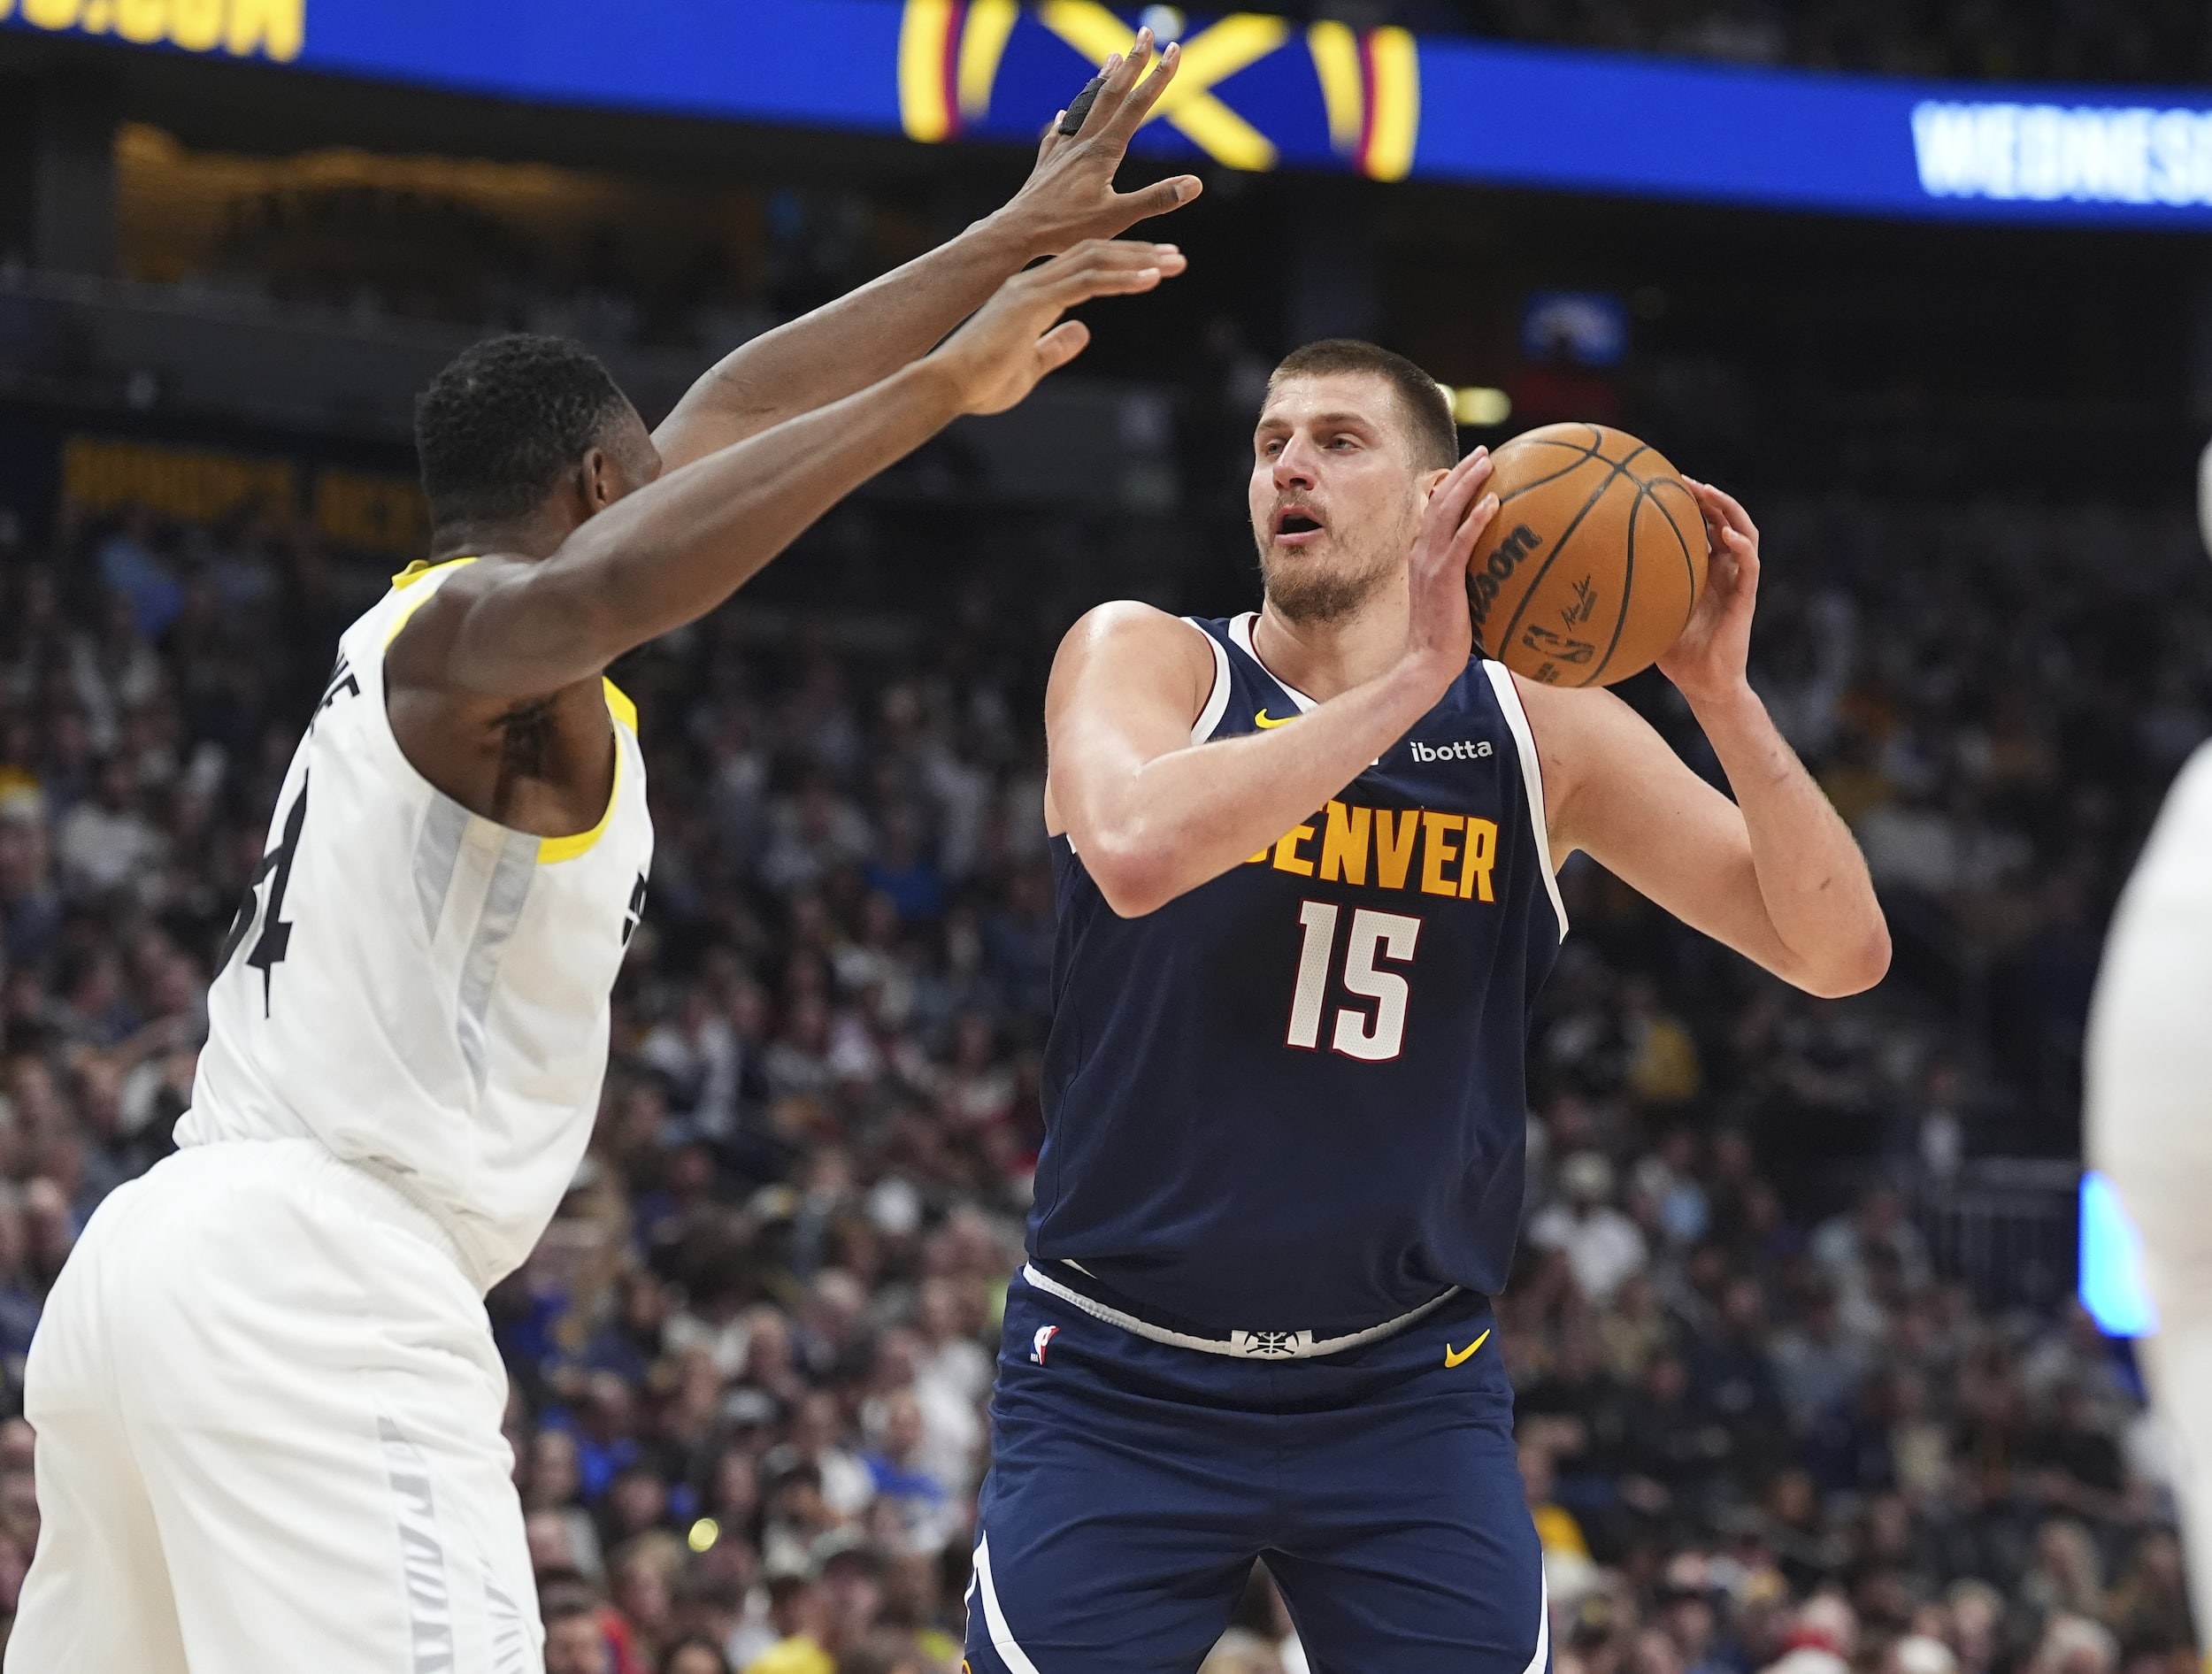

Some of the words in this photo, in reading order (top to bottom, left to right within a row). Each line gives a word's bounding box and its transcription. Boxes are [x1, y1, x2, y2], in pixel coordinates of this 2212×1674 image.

[1409, 740, 1494, 763] ibotta
[1241, 798, 1498, 903] ENVER
[1285, 899, 1423, 1063] 15
